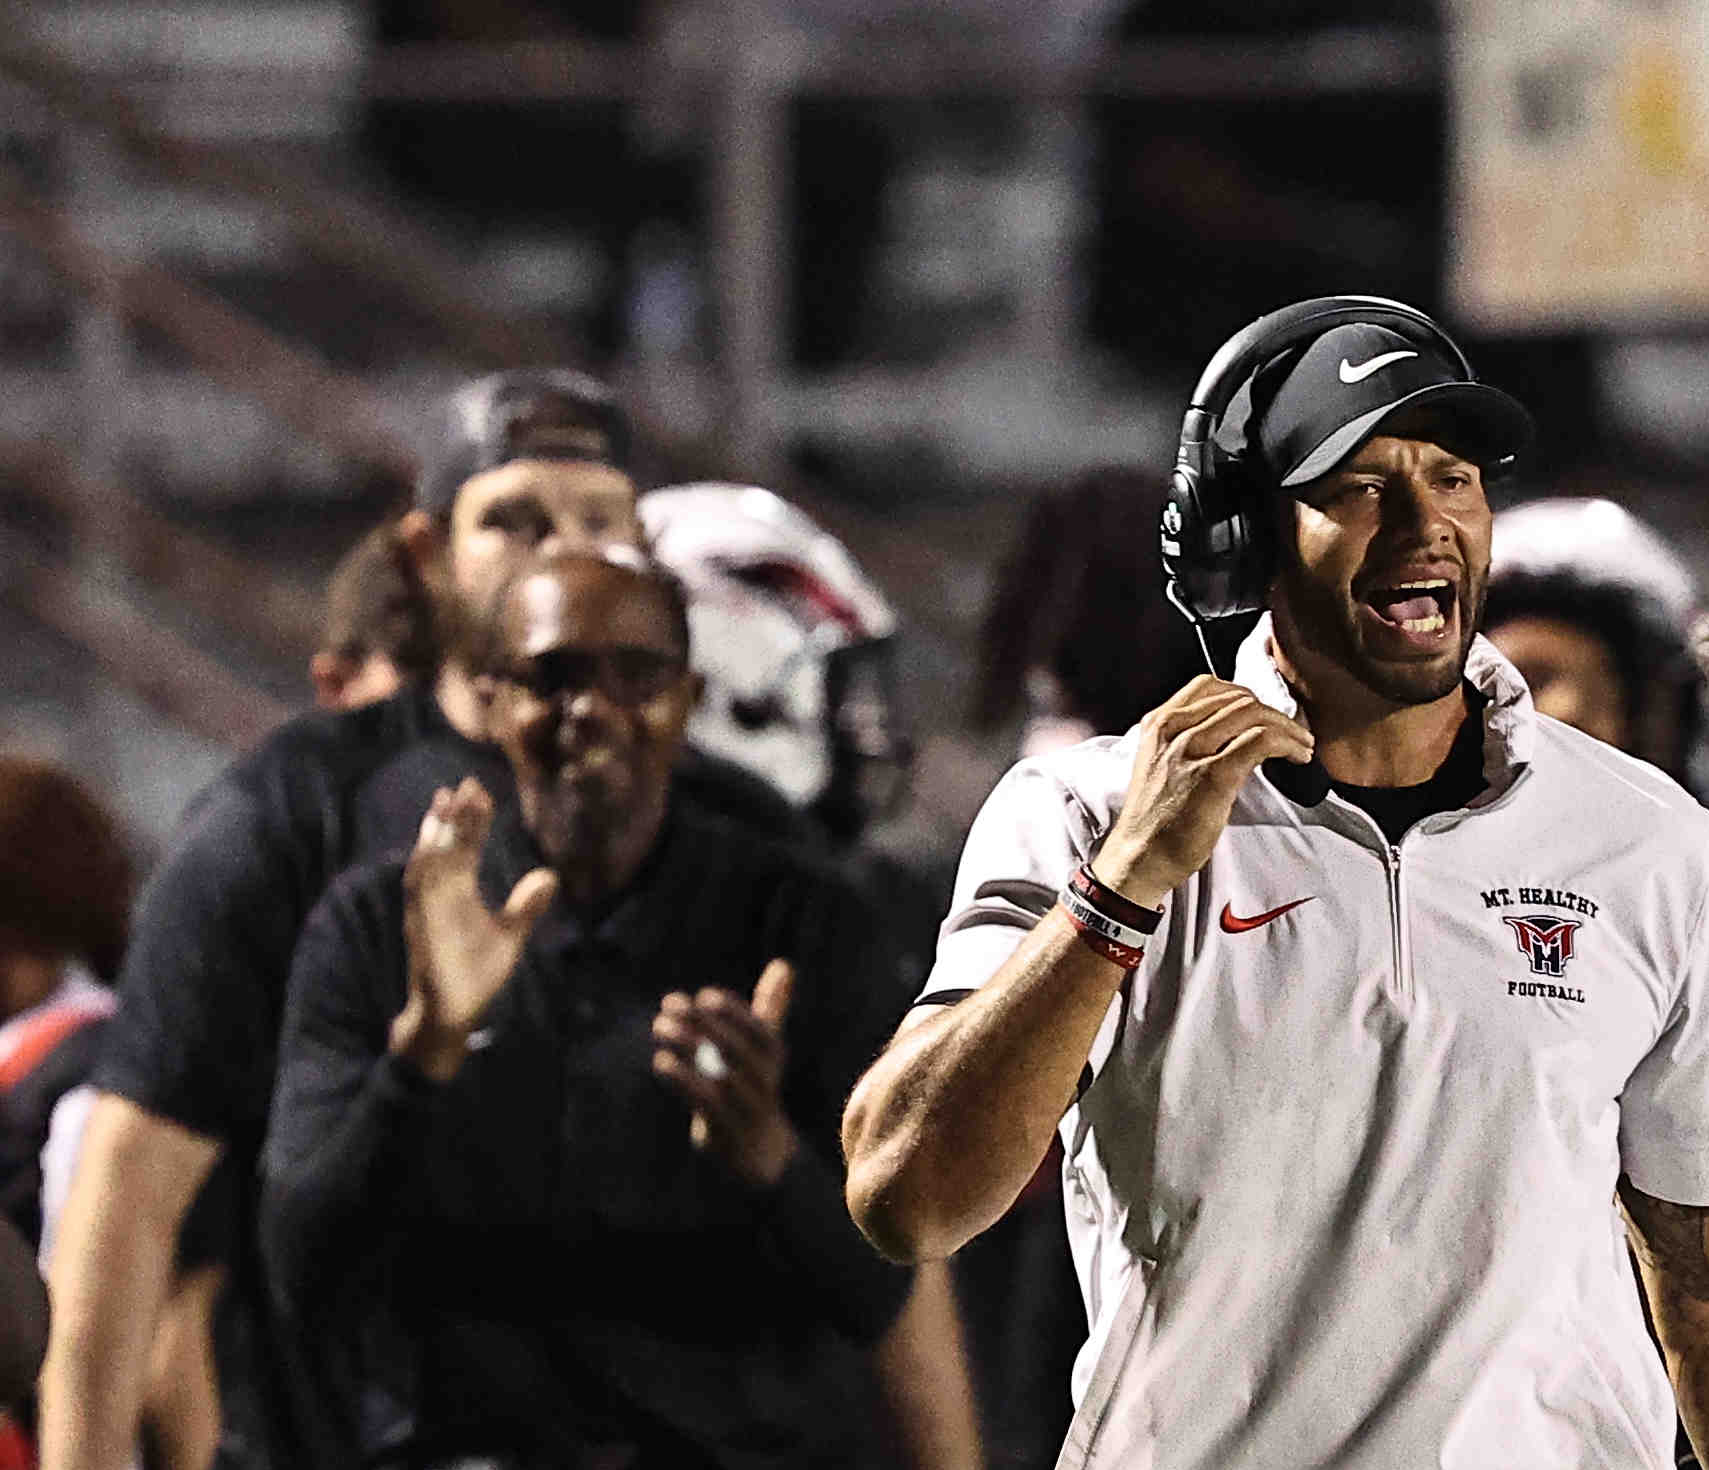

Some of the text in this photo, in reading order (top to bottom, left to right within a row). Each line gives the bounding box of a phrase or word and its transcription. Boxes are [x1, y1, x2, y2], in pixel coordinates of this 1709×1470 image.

[1480, 888, 1599, 919] MT. HEALTHY
[1507, 981, 1586, 1004] FOOTBALL
